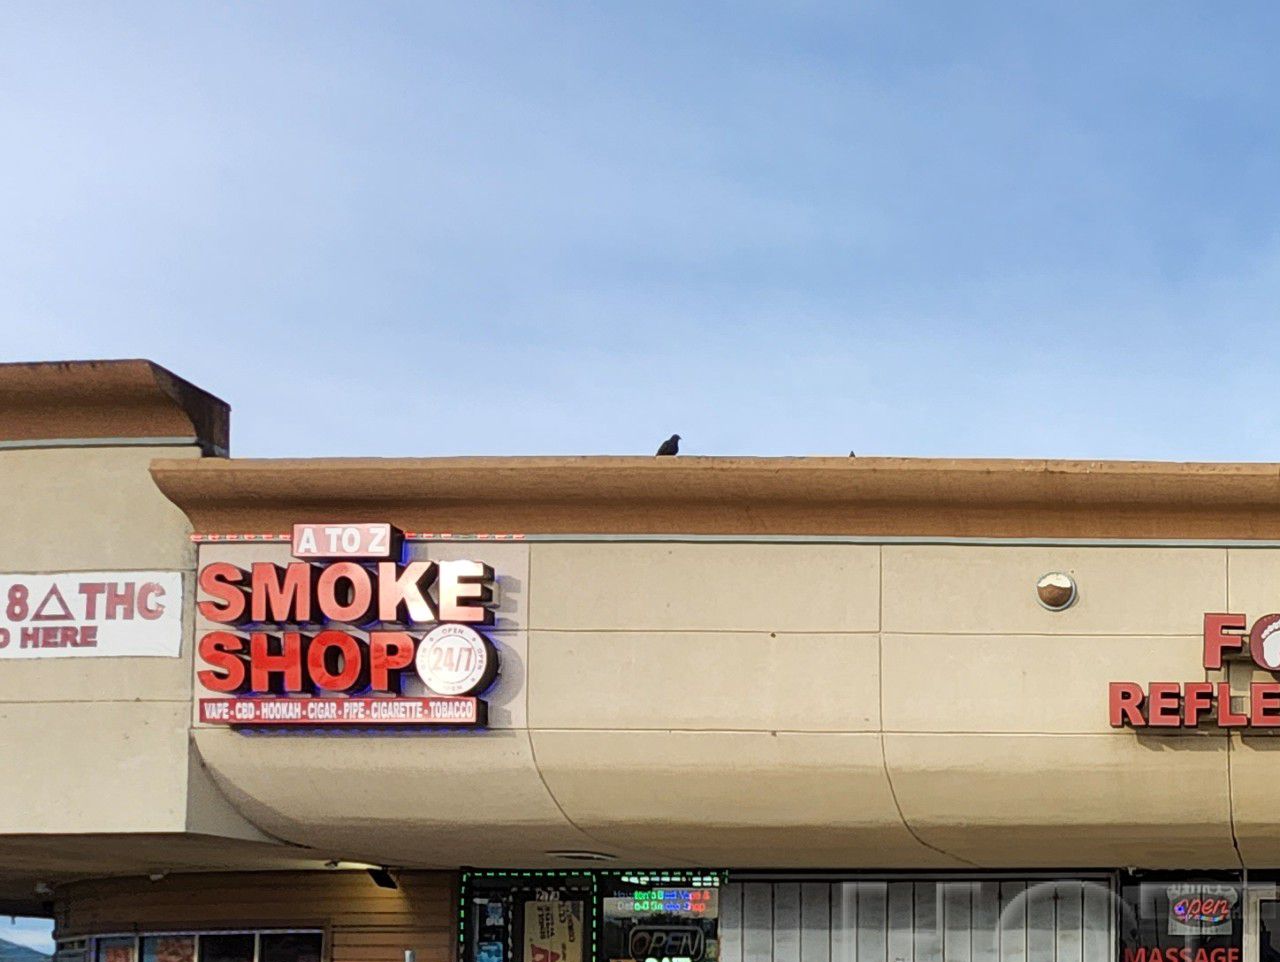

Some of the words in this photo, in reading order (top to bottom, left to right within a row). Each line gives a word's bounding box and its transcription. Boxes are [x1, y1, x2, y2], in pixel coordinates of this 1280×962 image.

[298, 527, 318, 553] A
[325, 527, 361, 553] TO
[367, 527, 387, 553] Z
[197, 561, 485, 622] SMOKE
[20, 626, 98, 648] HERE
[441, 627, 465, 635] OPEN
[197, 630, 415, 692] SHOP
[432, 646, 473, 673] 24/7
[204, 702, 230, 719] VAPE
[235, 702, 255, 719] CBD
[261, 702, 301, 719] HOOKAH
[307, 702, 337, 719] CIGAR
[343, 701, 365, 719] PIPE
[371, 701, 423, 719] CIGARETTE
[429, 701, 473, 719] TOBACCO
[632, 932, 701, 955] OPEN
